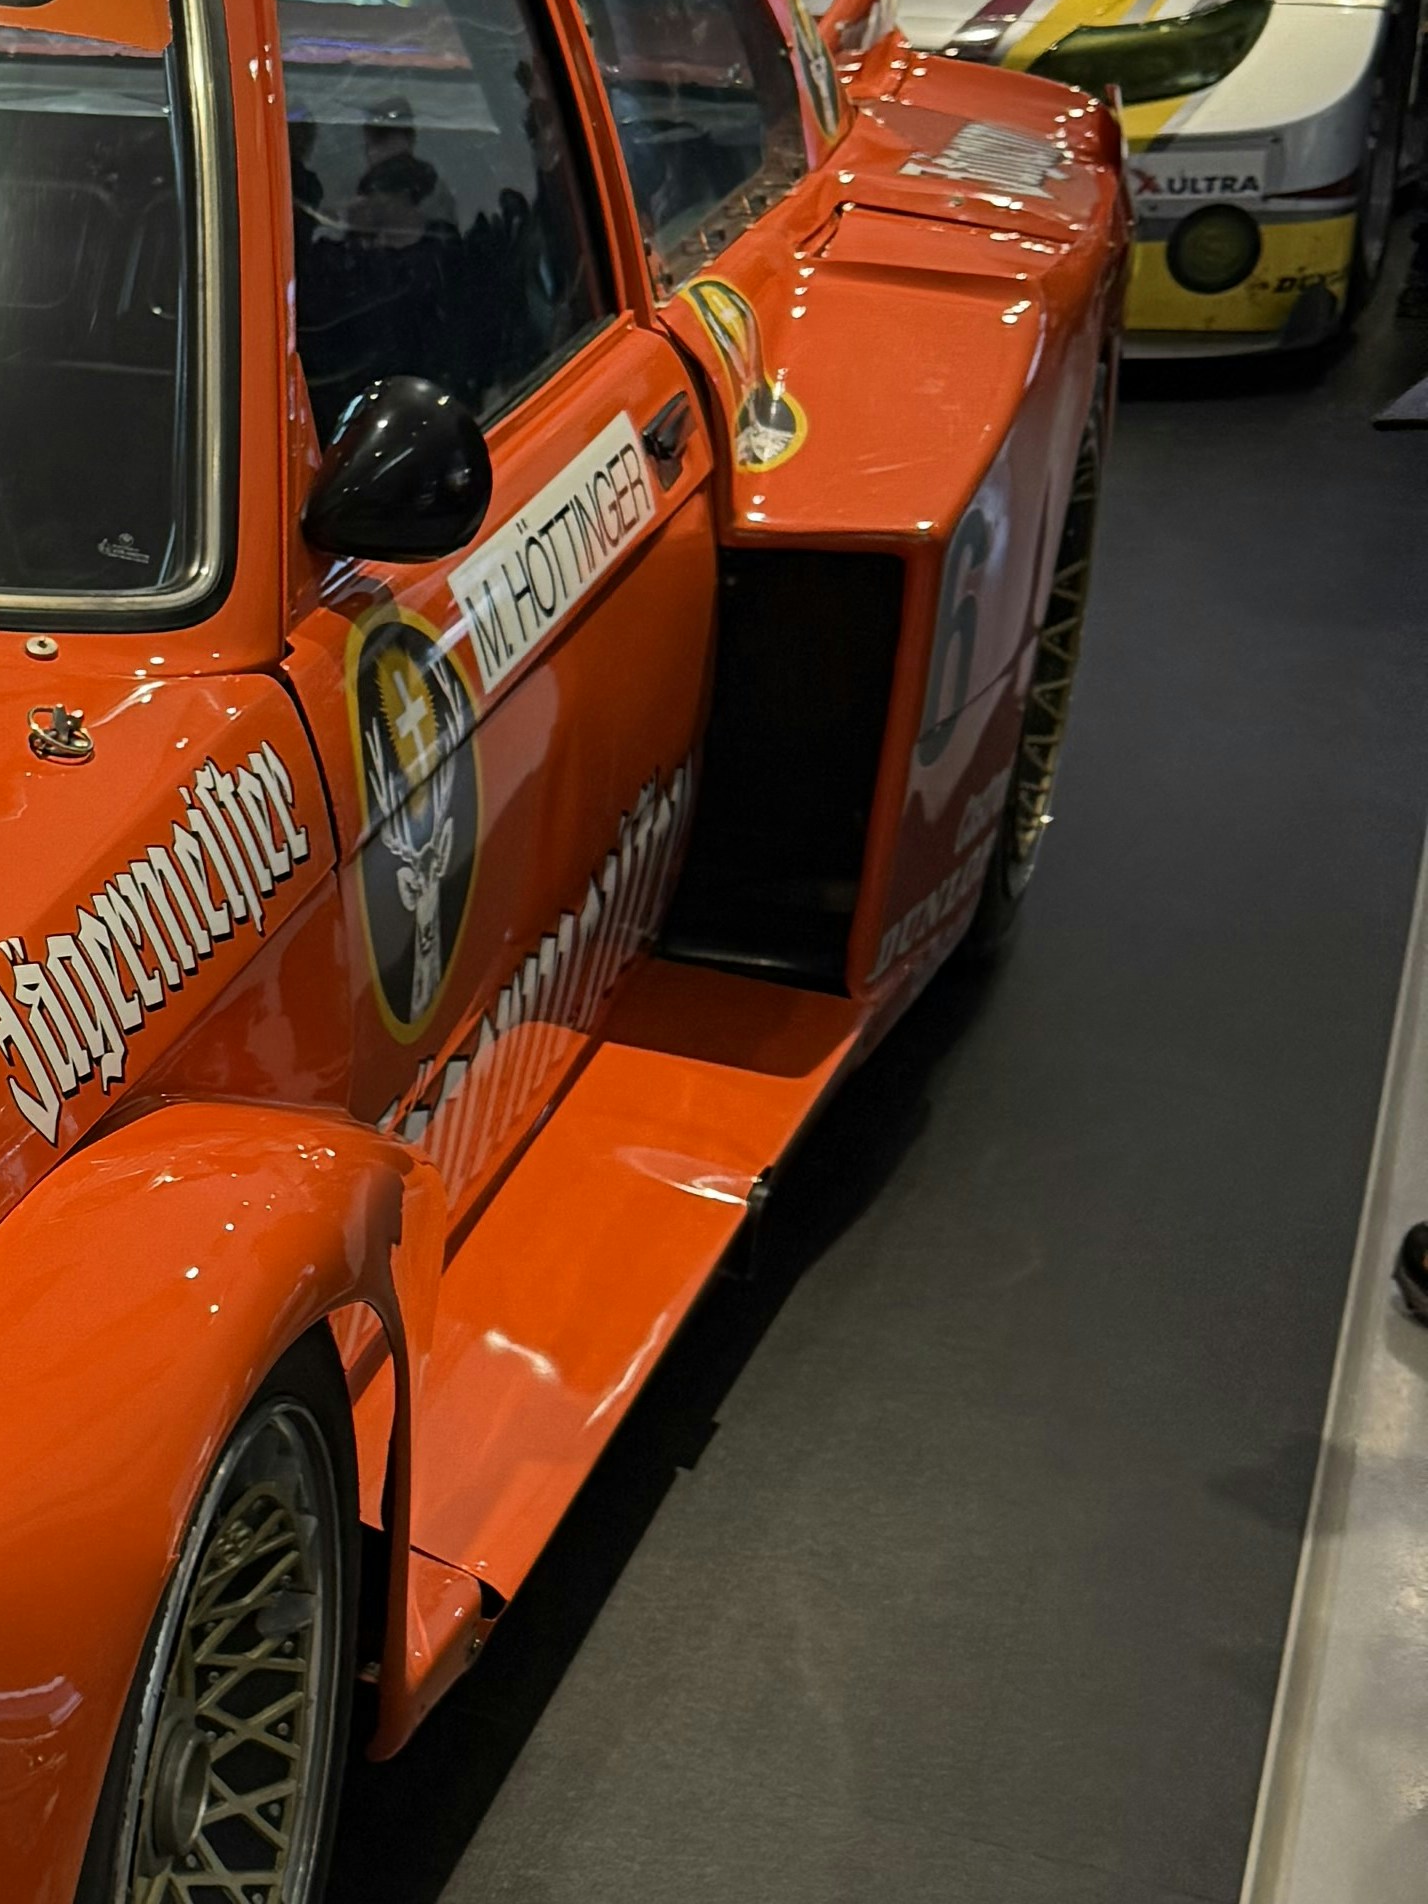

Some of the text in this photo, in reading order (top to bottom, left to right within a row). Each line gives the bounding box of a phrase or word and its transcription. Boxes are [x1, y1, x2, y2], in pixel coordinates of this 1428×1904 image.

[1166, 174, 1259, 195] ULTRA
[464, 441, 653, 680] M. HÖTTINGER
[918, 508, 989, 767] 6
